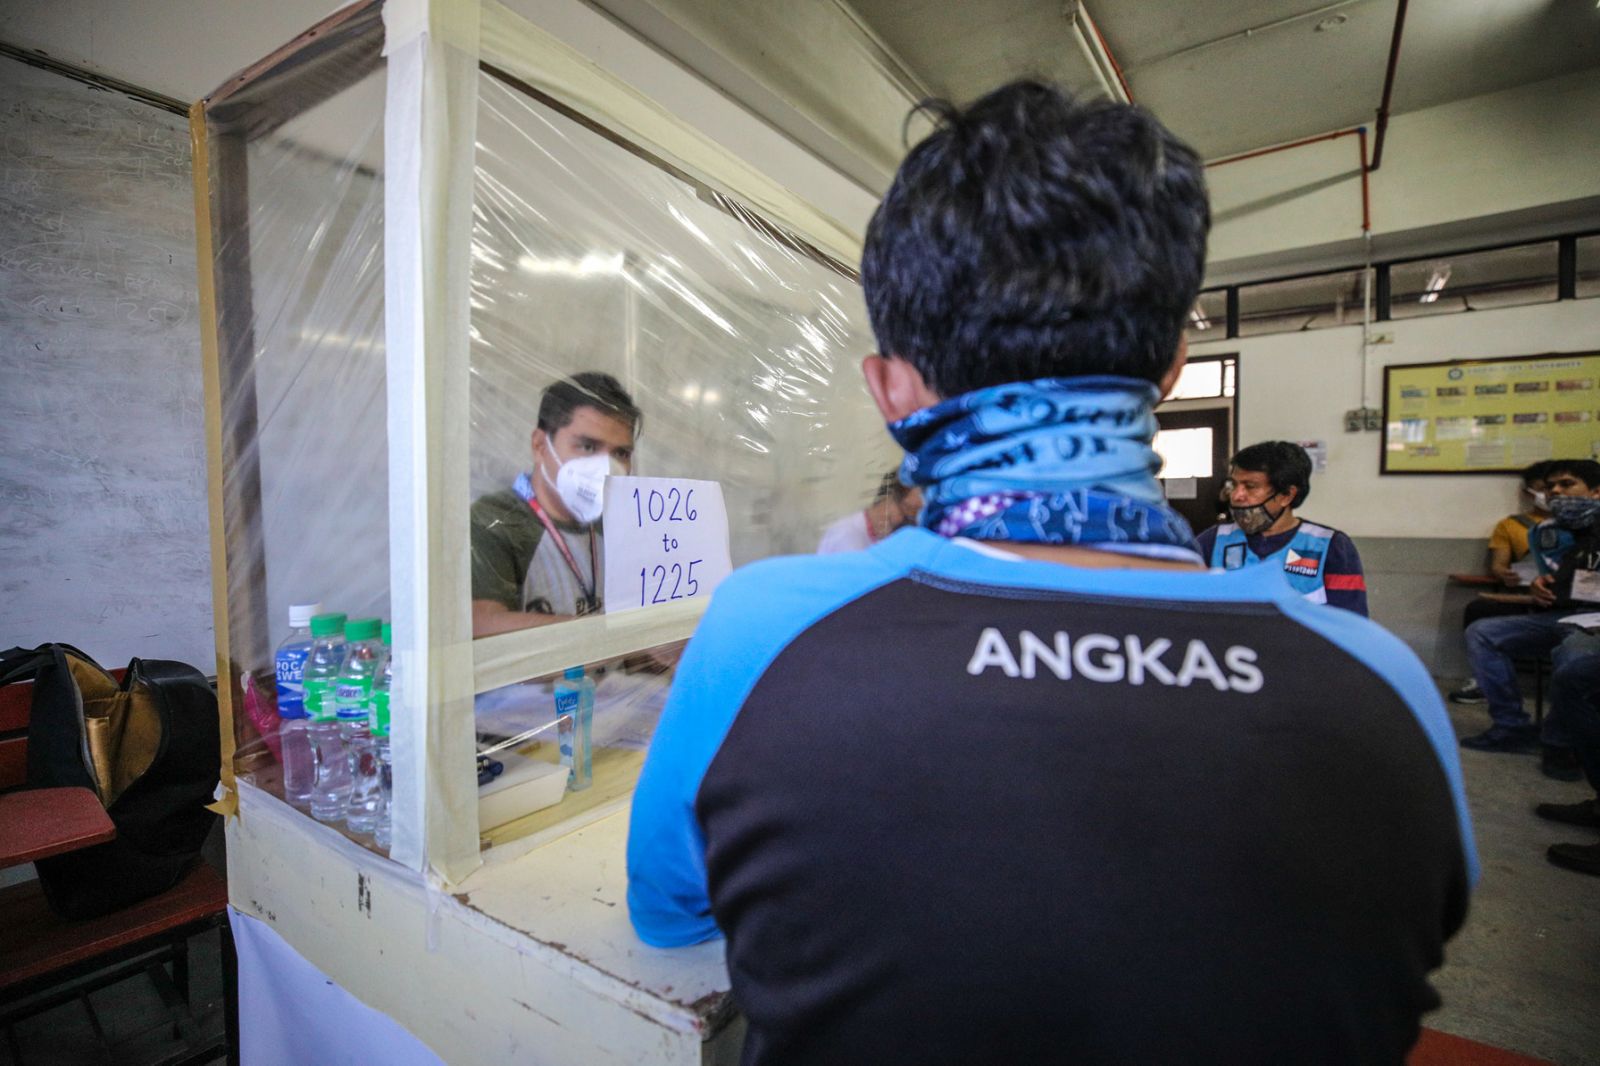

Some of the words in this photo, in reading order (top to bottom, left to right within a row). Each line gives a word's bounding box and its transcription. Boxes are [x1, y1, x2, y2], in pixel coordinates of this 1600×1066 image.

[633, 487, 698, 528] 1026
[662, 533, 679, 553] to
[640, 559, 703, 607] 1225
[966, 626, 1265, 694] ANGKAS
